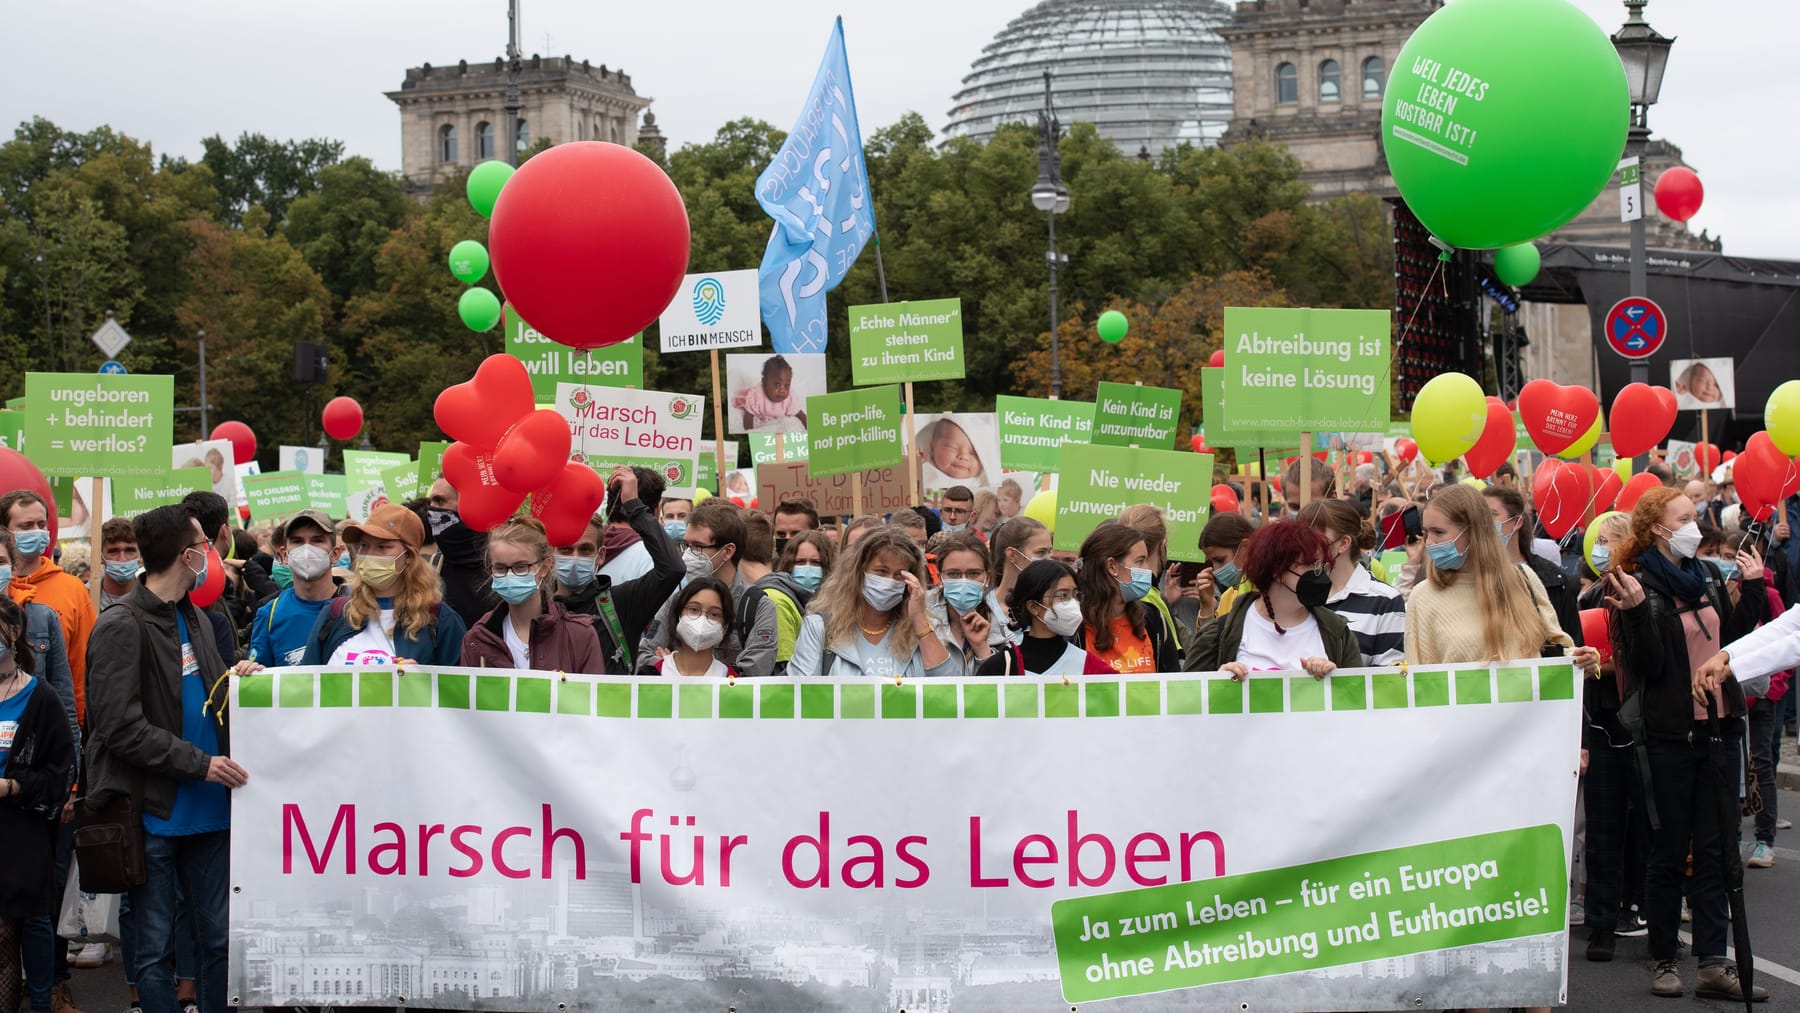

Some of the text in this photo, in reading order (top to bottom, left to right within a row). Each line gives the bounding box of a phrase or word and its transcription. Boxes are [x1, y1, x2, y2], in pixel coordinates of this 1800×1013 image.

[1412, 56, 1490, 101] WEIL JEDES
[1416, 82, 1458, 116] LEBEN
[1395, 98, 1443, 134] KOSTBAR
[1445, 121, 1477, 148] IST!
[1627, 196, 1633, 214] 5
[853, 309, 959, 334] „Echte Männer“
[668, 330, 754, 348] ICH BIN MENSCH
[886, 331, 928, 346] stehen
[1236, 331, 1382, 362] Abtreibung ist
[521, 352, 628, 376] will leben
[862, 345, 955, 367] zu ihrem Kind
[1242, 364, 1375, 395] keine Lösung
[50, 384, 149, 407] ungeboren
[46, 408, 154, 428] + behindert
[576, 400, 657, 424] Marsch
[822, 404, 886, 428] Be pro-life,
[1004, 410, 1092, 431] Kein Kind ist
[1103, 398, 1173, 420] Kein Kind ist
[52, 433, 147, 452] = wertlos?
[570, 420, 693, 451] ür das Leben
[814, 426, 896, 450] not pro-killing
[755, 446, 794, 463] Groe
[134, 486, 194, 500] Nie wieder
[1090, 469, 1182, 494] Nie wieder
[1126, 656, 1152, 668] LIFE
[282, 803, 1226, 888] Marsch für das Leben
[1079, 916, 1110, 942] Ja
[1118, 911, 1178, 936] zum
[1186, 895, 1267, 926] Leben
[1300, 878, 1340, 908] für
[1350, 872, 1391, 900] ein
[1399, 860, 1499, 892] Europa
[1085, 887, 1550, 983] ohne Abtreibung und Euthanasie!
